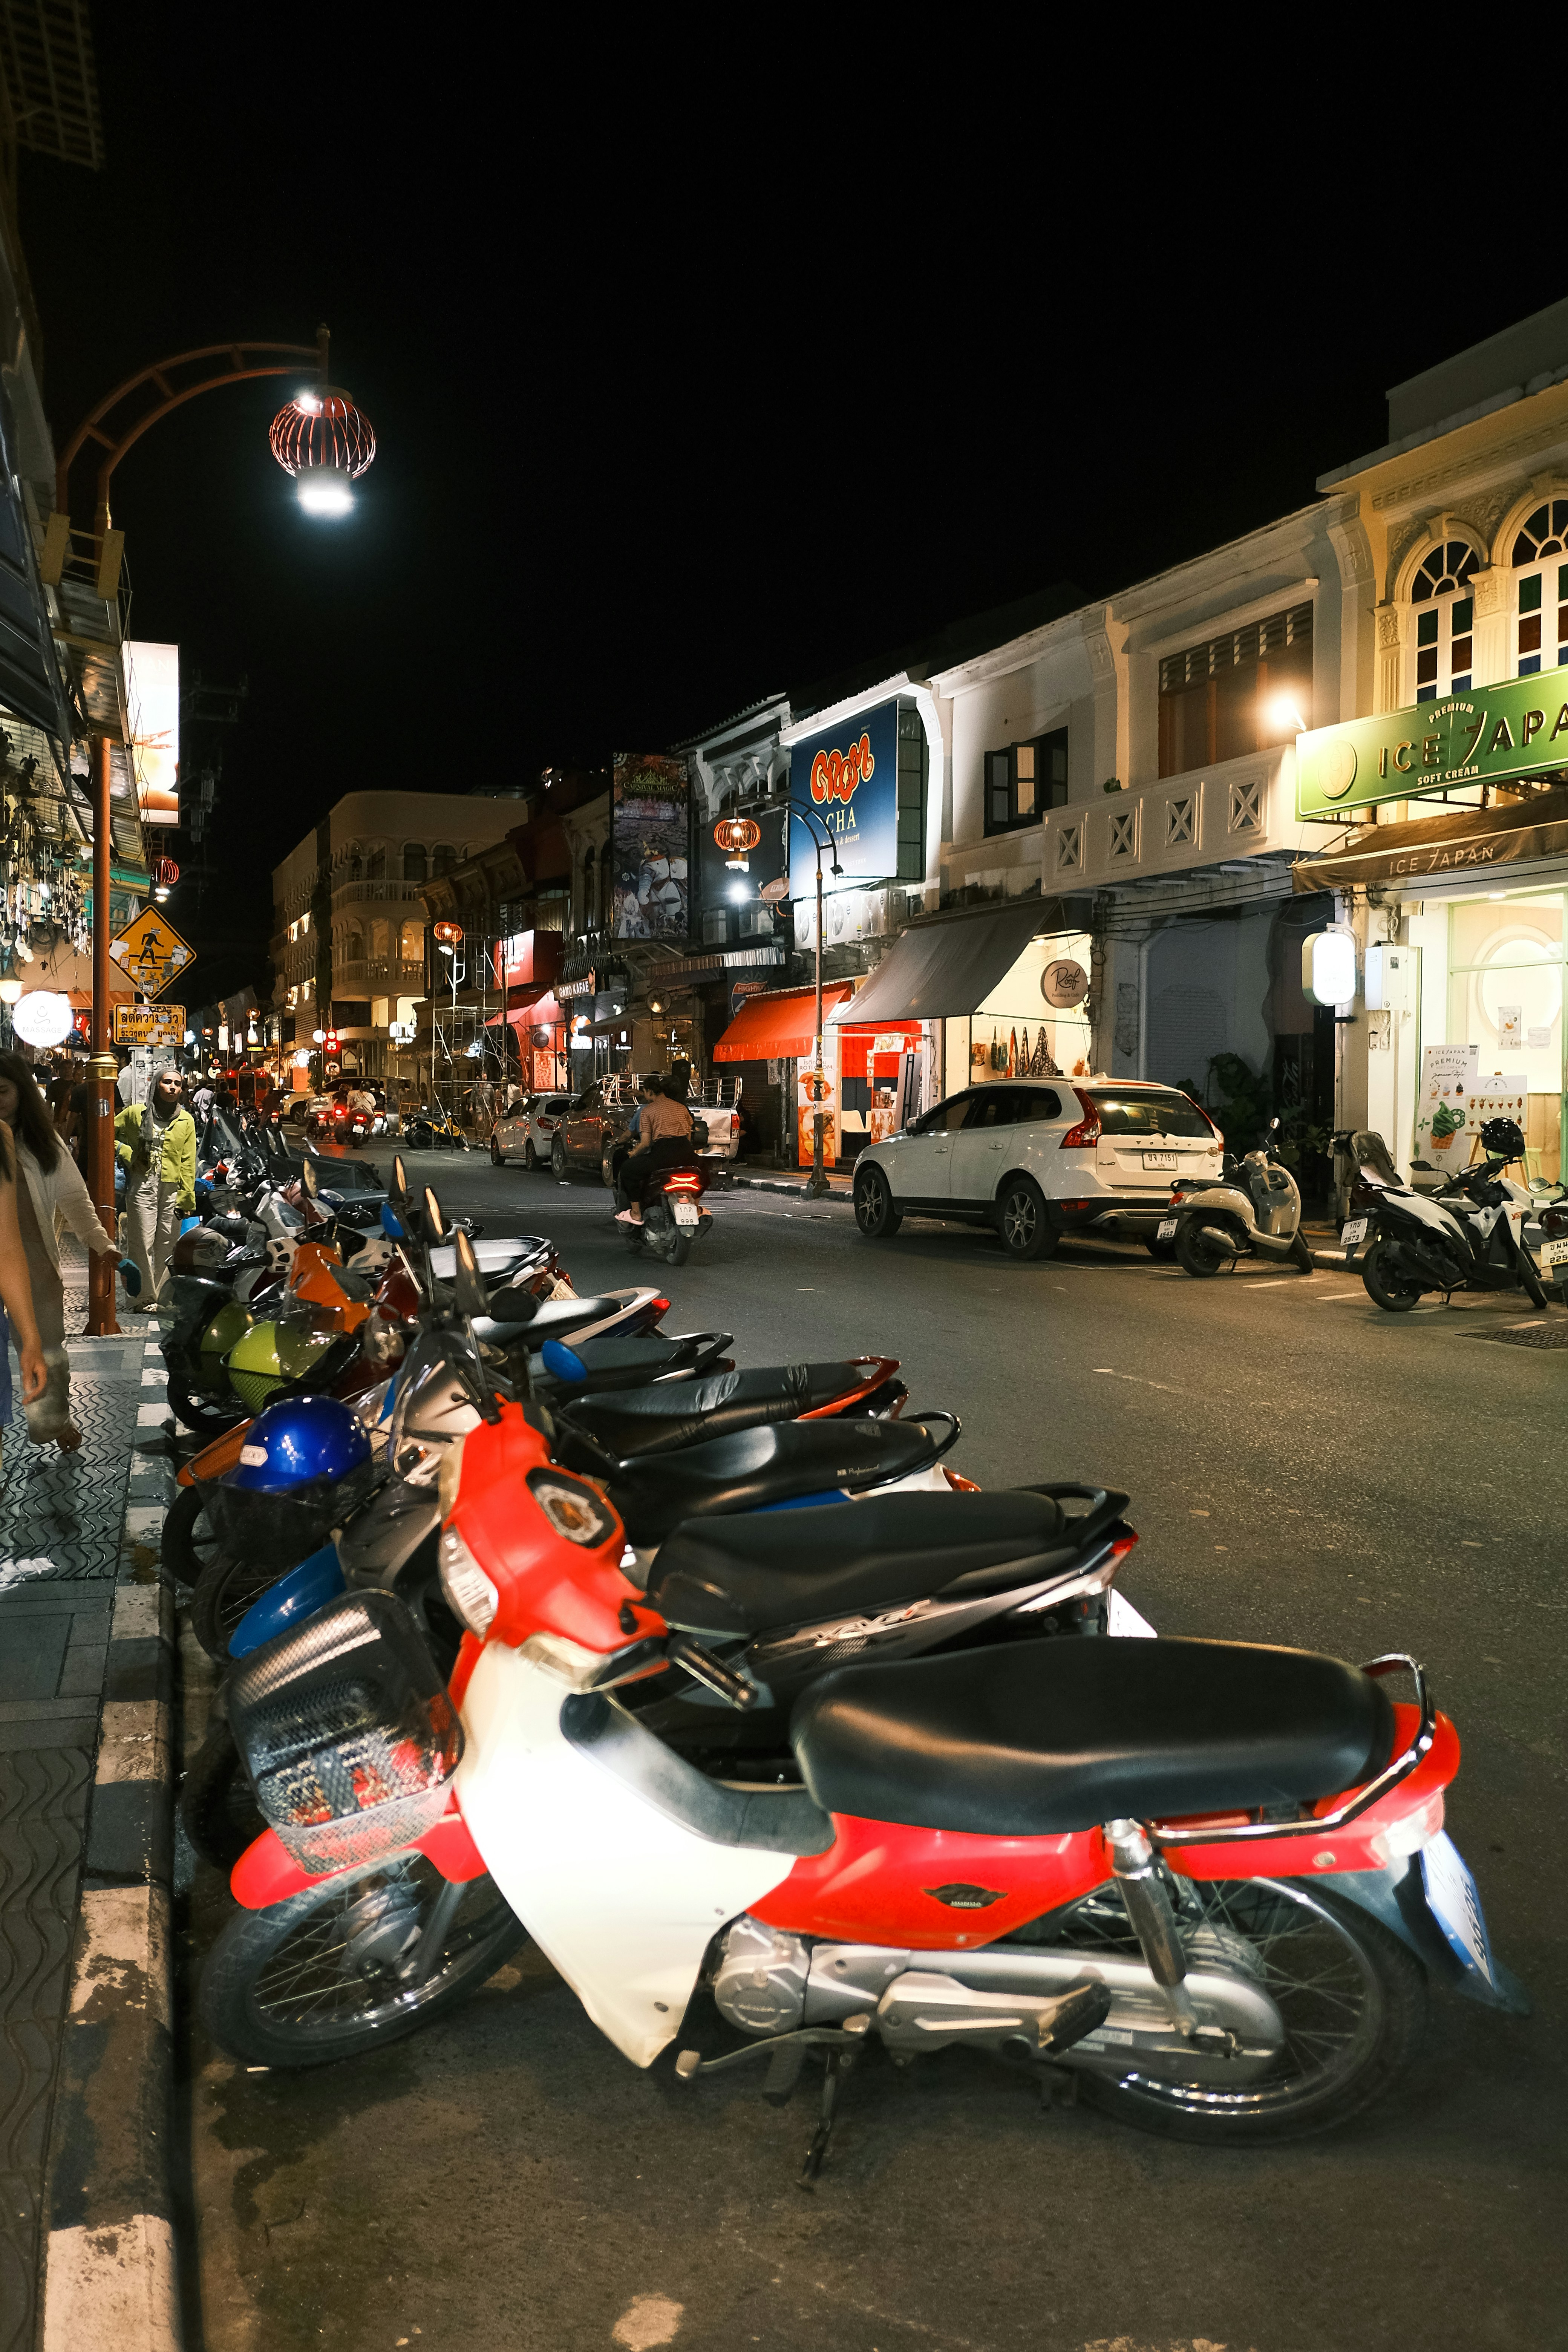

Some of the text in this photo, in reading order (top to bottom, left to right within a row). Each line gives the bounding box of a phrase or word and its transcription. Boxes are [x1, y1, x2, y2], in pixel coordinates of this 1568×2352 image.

[1429, 703, 1474, 723] PREMIUM
[1378, 733, 1440, 777] ICE
[1418, 765, 1479, 786] SOFT CREAM
[624, 782, 654, 790] CARNIVAL
[657, 784, 678, 792] MAGIC
[826, 806, 856, 835] CHA
[845, 833, 860, 844] dessert
[1390, 858, 1419, 875] ICE
[573, 980, 589, 995] KAFAE
[1051, 967, 1081, 992] Roof
[327, 1041, 337, 1050] 25
[1430, 1058, 1467, 1068] PREMIUM
[1344, 1234, 1360, 1243] 2573
